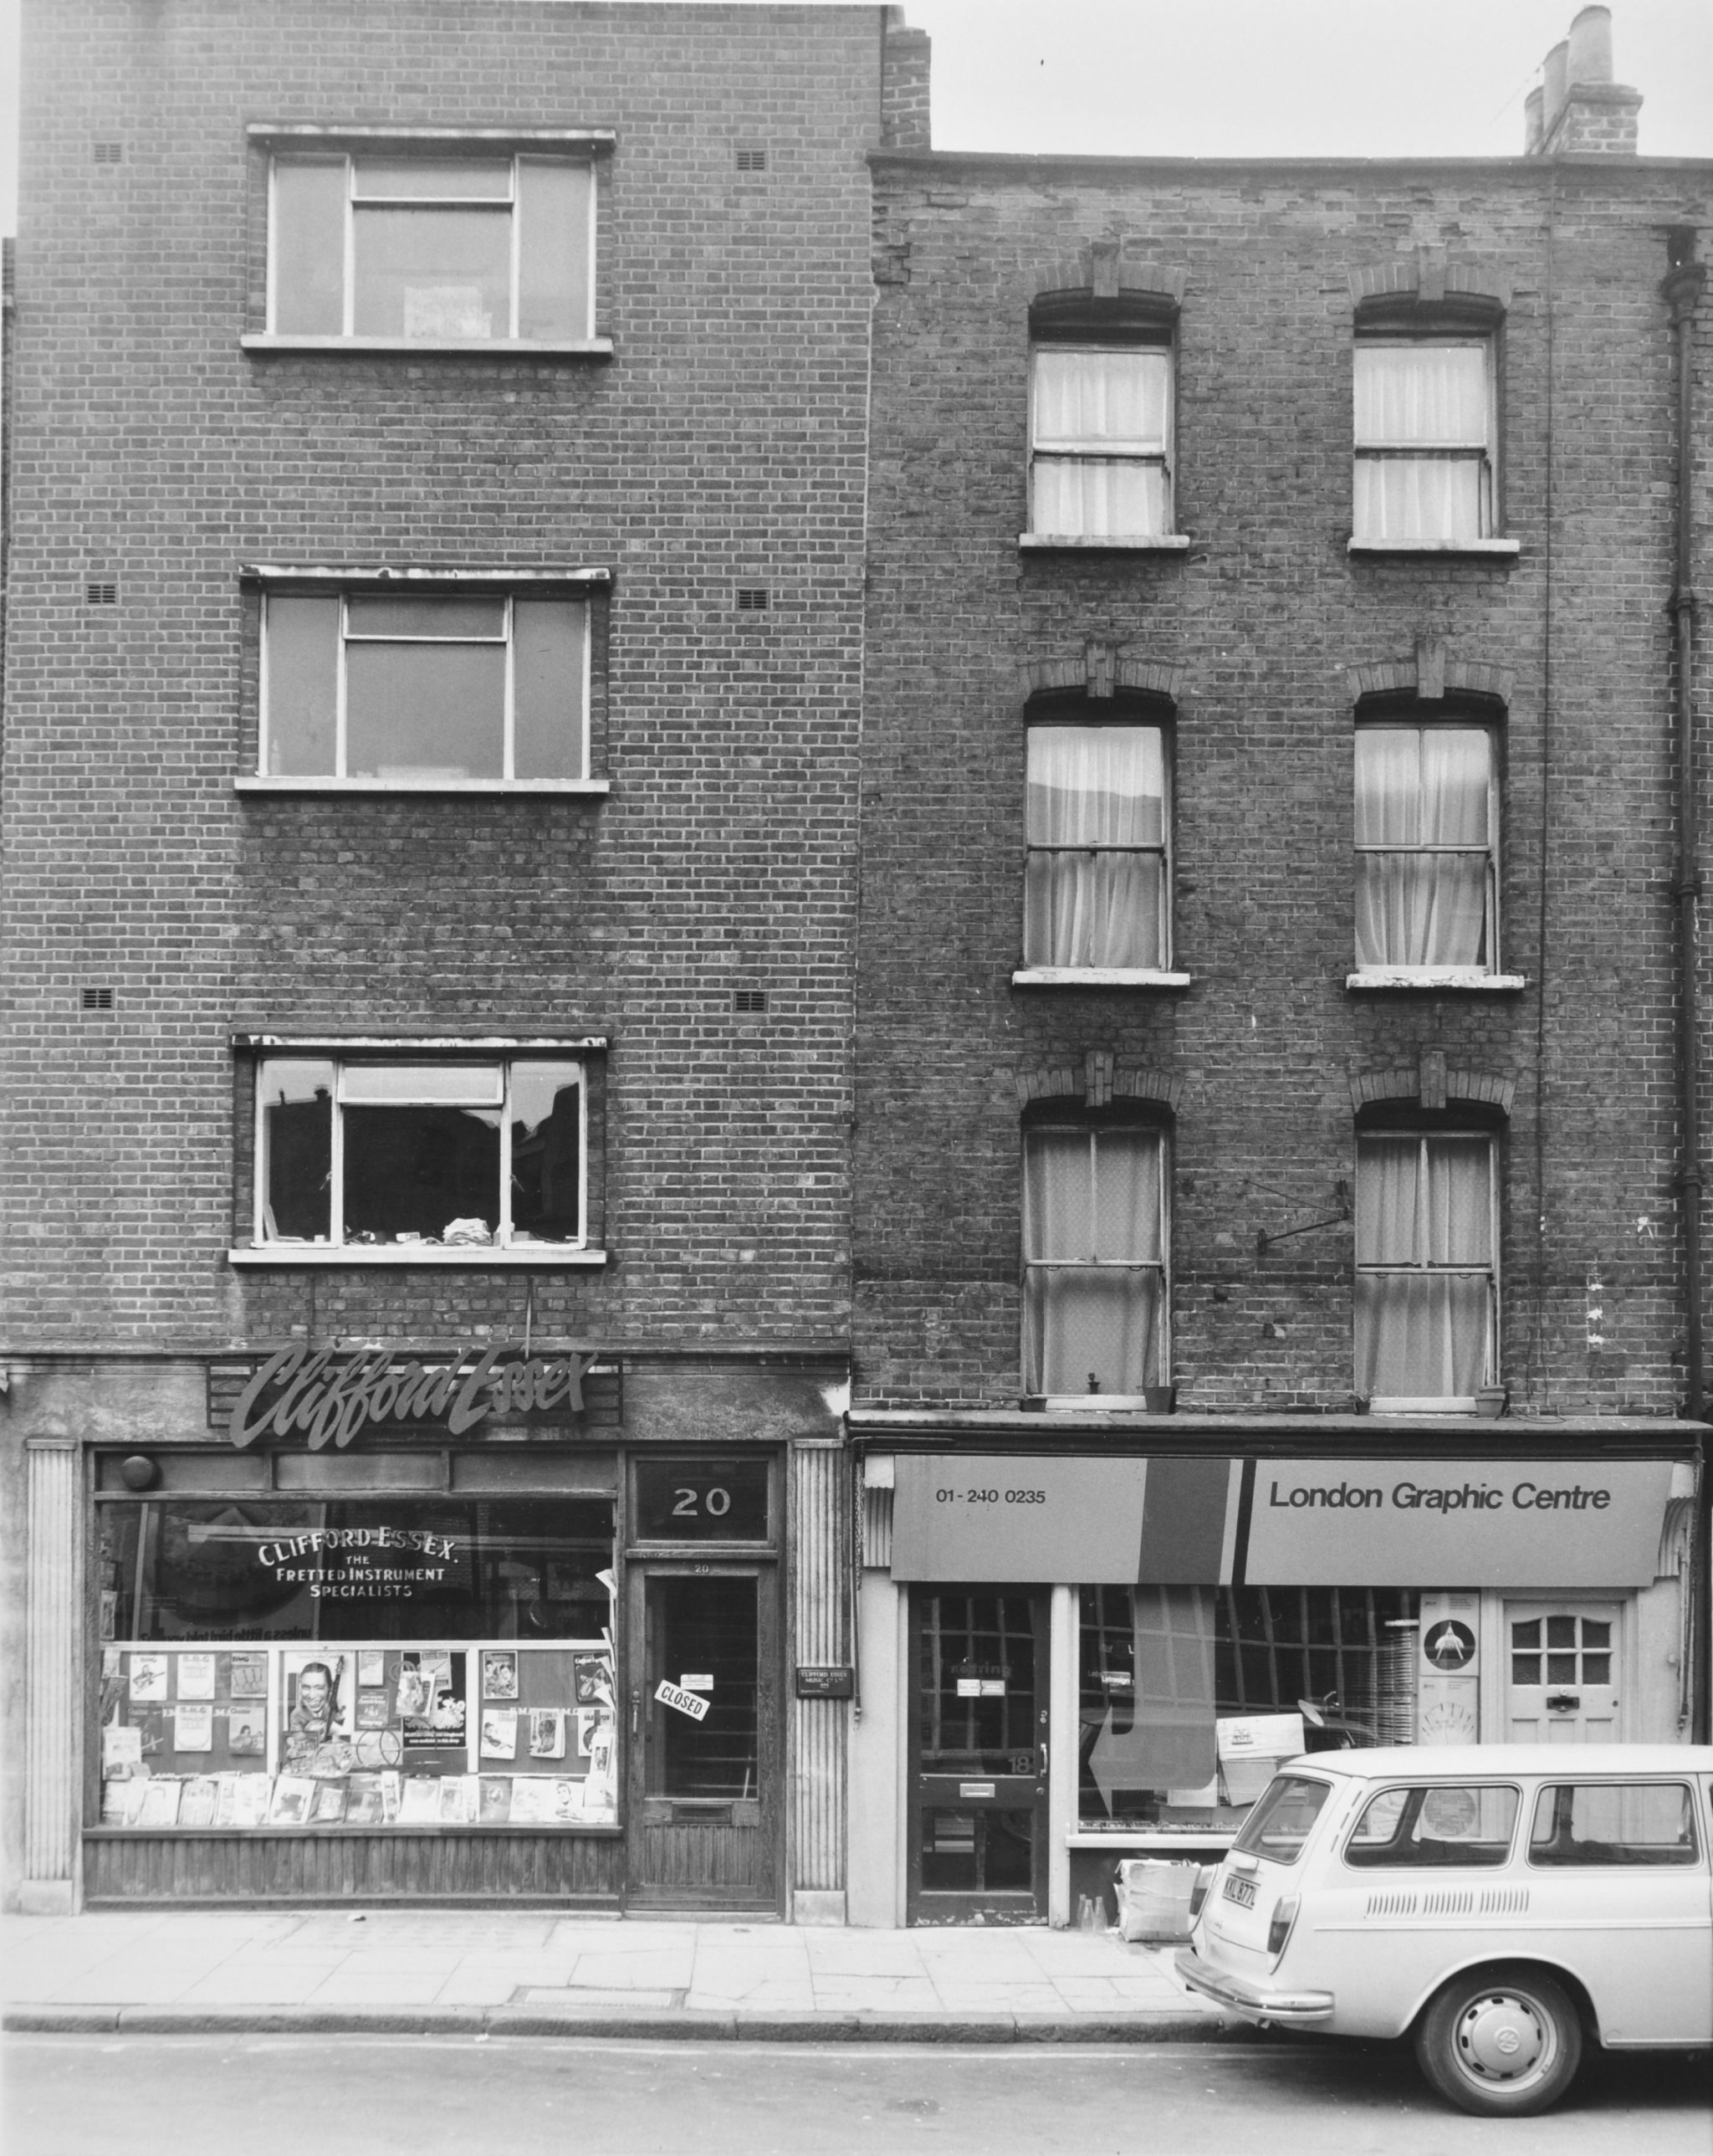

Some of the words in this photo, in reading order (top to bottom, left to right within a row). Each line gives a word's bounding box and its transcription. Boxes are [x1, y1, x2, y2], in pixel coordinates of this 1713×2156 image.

[230, 1343, 474, 1450] Clifford
[448, 1342, 599, 1435] Essex
[672, 1488, 731, 1515] 20
[1005, 1490, 1046, 1503] 0235
[1270, 1482, 1383, 1508] London
[1392, 1483, 1503, 1514] Graphic
[1512, 1483, 1611, 1509] Centre
[258, 1529, 371, 1566] CLIFFORD
[345, 1556, 370, 1565] THE
[695, 1565, 708, 1573] 20
[276, 1568, 346, 1581] FRETTED
[349, 1567, 445, 1580] INSTRUMENT
[309, 1585, 412, 1597] SPECIALISTS
[661, 1686, 703, 1714] CLOSED
[1008, 1756, 1030, 1774] 18
